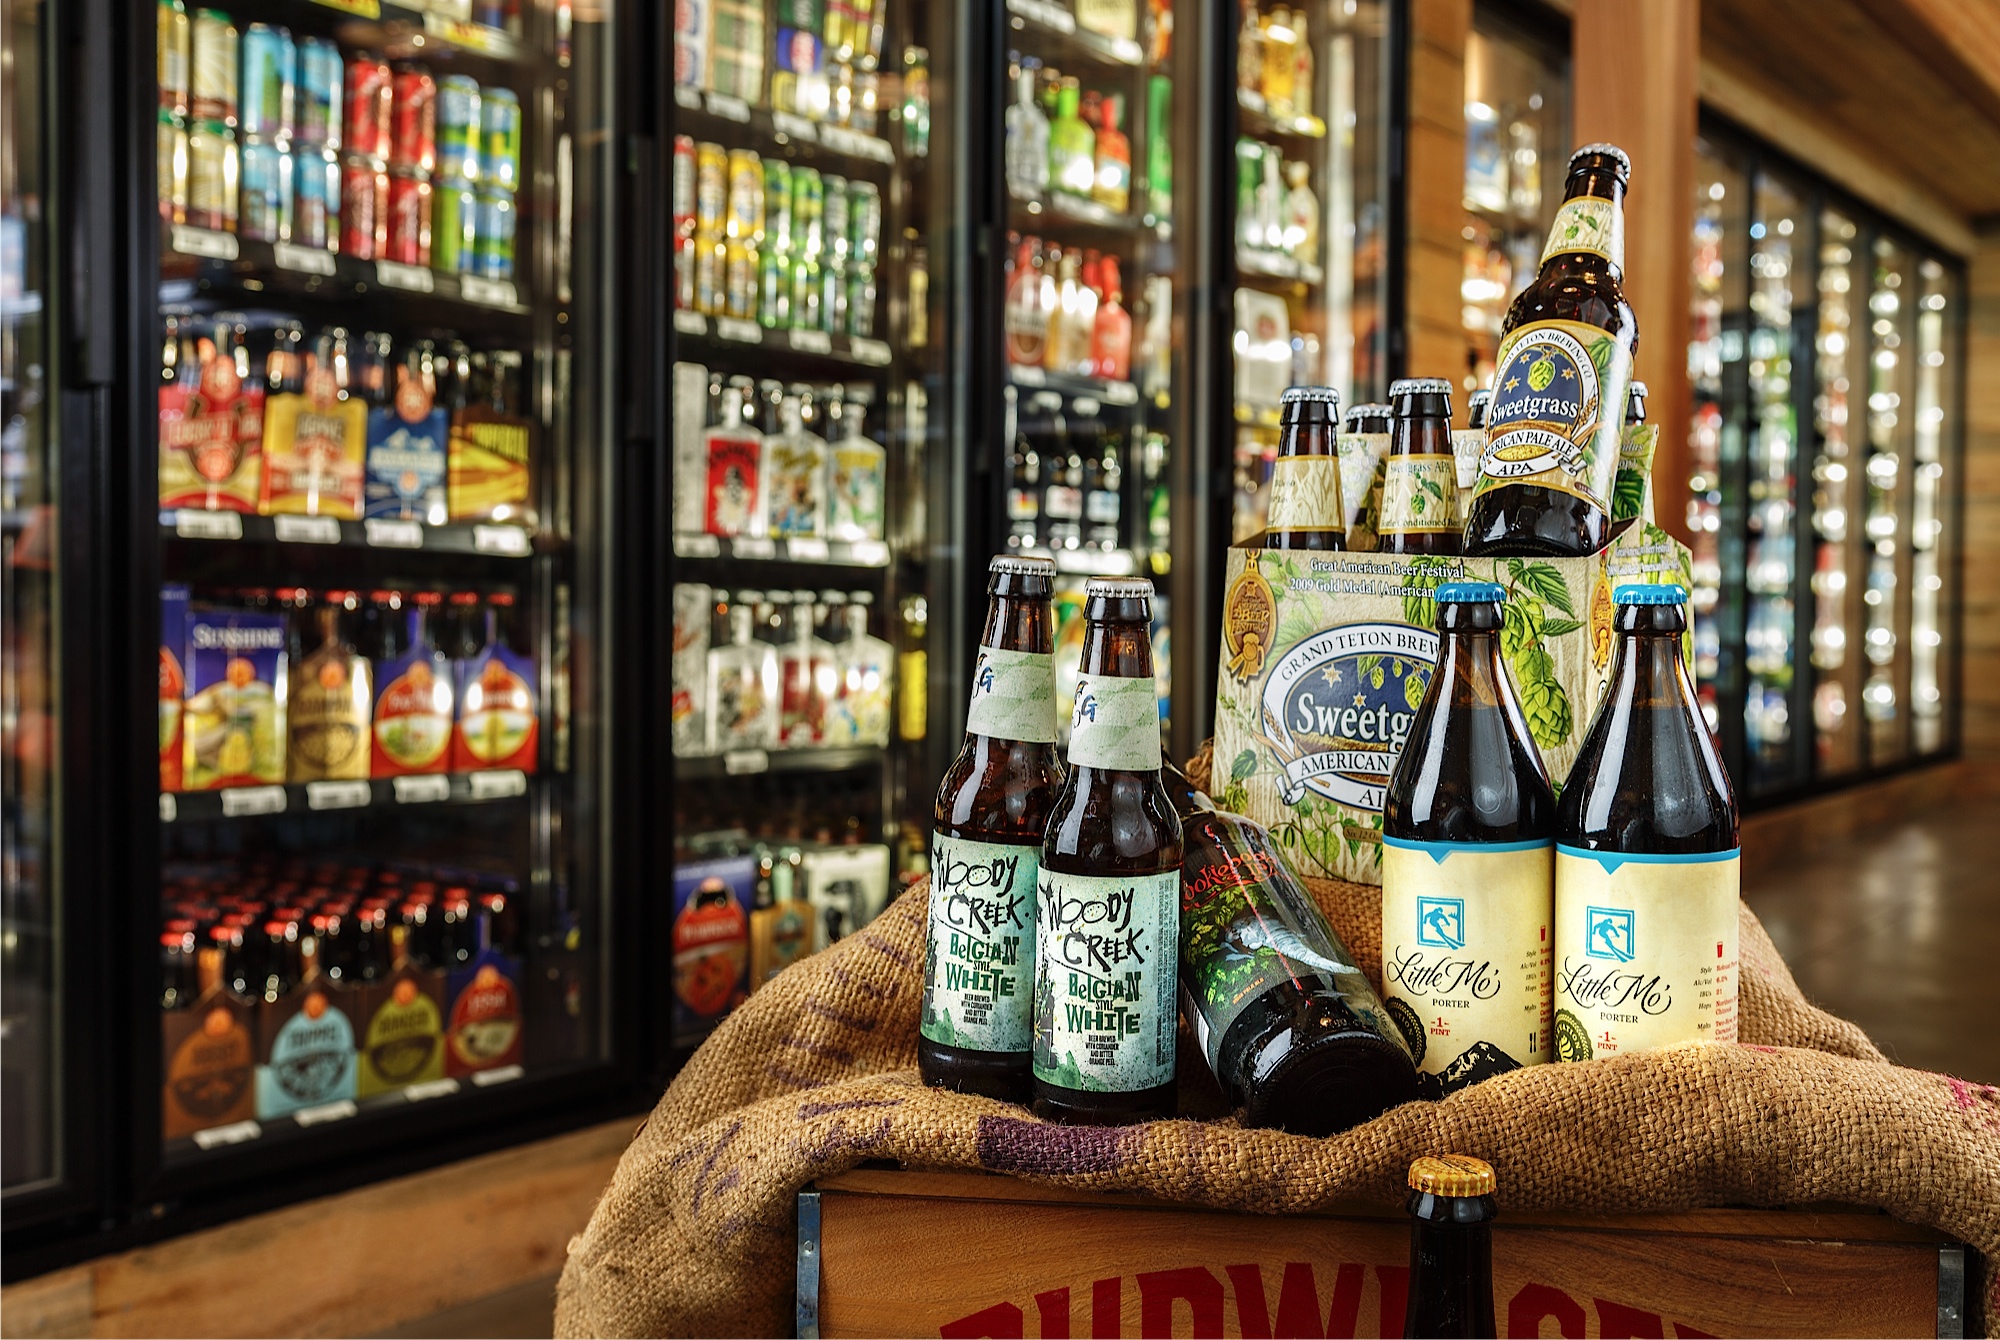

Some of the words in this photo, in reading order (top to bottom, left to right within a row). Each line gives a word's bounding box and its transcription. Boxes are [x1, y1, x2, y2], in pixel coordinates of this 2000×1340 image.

[1515, 333, 1546, 352] TETON
[1547, 332, 1586, 363] BREWING
[1490, 395, 1578, 427] Sweetgrass
[1482, 432, 1525, 465] AMERICAN
[1525, 431, 1552, 448] PALE
[1553, 440, 1575, 457] ALE
[1434, 460, 1451, 473] APA
[1496, 463, 1536, 476] APA
[1311, 558, 1338, 572] Great
[1340, 560, 1391, 576] American
[1393, 562, 1418, 577] Beer
[1420, 563, 1465, 579] Festival
[1290, 578, 1313, 591] 2009
[1315, 580, 1340, 593] Gold
[1342, 581, 1375, 595] Medal
[1378, 581, 1435, 598] (American
[1281, 640, 1333, 681] GRAND
[1336, 632, 1392, 651] TETON
[1397, 633, 1440, 656] BREW
[1297, 693, 1411, 753] Sweetg
[1301, 754, 1390, 777] AMERICAN
[1346, 828, 1356, 839] Six
[1359, 829, 1368, 840] 12
[933, 849, 1019, 897] WOODY
[1039, 879, 1135, 933] WOODY
[948, 894, 1026, 935] CREEK
[1063, 928, 1145, 973] CREEK
[1526, 950, 1537, 959] Style
[973, 960, 990, 972] STYLE
[1520, 961, 1537, 970] Alc/Vol
[1700, 966, 1713, 975] Style
[1387, 945, 1452, 996] Little
[1436, 960, 1501, 1000] Mo'
[945, 962, 1016, 1002] WHITE
[1556, 956, 1621, 1009] Little
[1604, 974, 1672, 1015] Mo'
[1693, 977, 1713, 987] Alc/Vol
[1525, 984, 1537, 993] Hops
[964, 993, 974, 1001] BEER
[974, 994, 991, 1003] BREWED
[1432, 998, 1470, 1009] PORTER
[961, 1000, 971, 1008] WITH
[970, 1002, 993, 1011] CORIANDER
[1095, 999, 1114, 1011] STYLE
[1524, 1003, 1537, 1013] Malts
[973, 1009, 987, 1017] BITTER
[1600, 1011, 1639, 1024] PORTER
[963, 1015, 978, 1025] ORANGE
[1064, 1002, 1141, 1041] WHITE
[1697, 1021, 1712, 1030] Malts
[1430, 1027, 1451, 1037] PINT
[1088, 1034, 1098, 1042] BEER
[1099, 1035, 1116, 1043] BREWED
[1085, 1042, 1096, 1050] WITH
[1096, 1043, 1119, 1051] CORIANDER
[1597, 1042, 1618, 1051] PINT
[1090, 1050, 1099, 1058] AND
[1100, 1050, 1114, 1058] BITTER
[1089, 1058, 1105, 1066] ORANGE
[1105, 1058, 1116, 1066] PEEL
